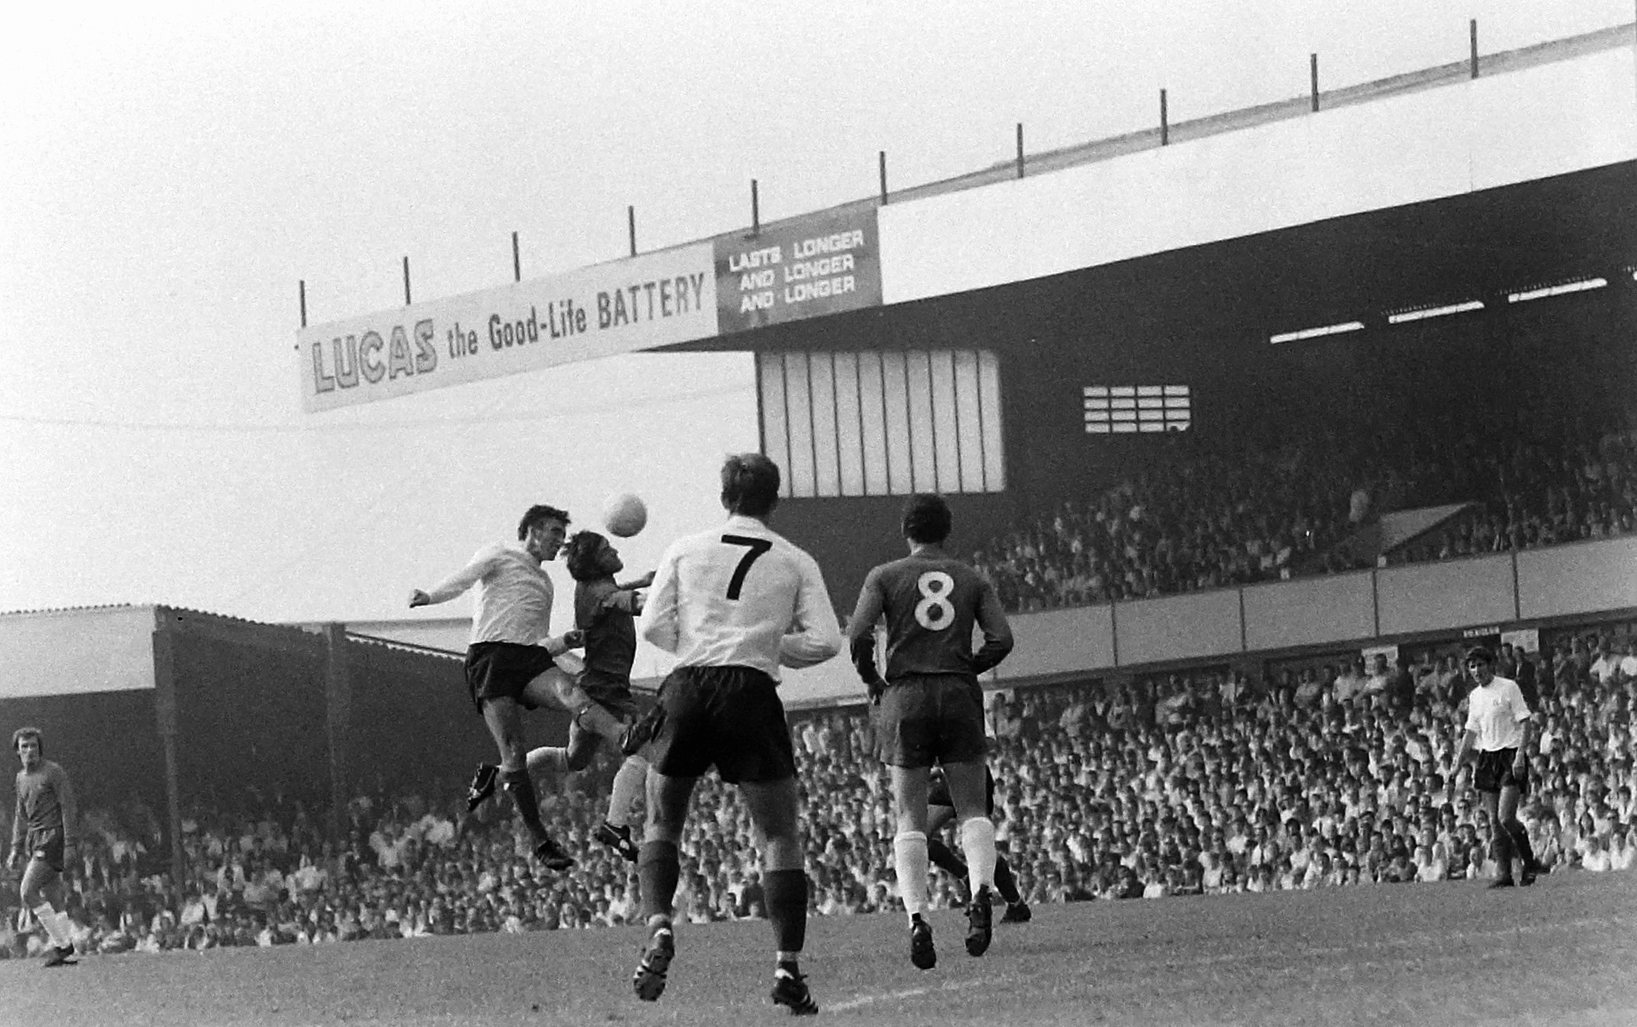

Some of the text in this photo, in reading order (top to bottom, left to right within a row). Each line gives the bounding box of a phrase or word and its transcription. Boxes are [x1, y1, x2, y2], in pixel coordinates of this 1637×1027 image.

[729, 229, 863, 272] LASTS LONGER
[740, 253, 854, 291] AND LONGER
[740, 274, 855, 314] AND LONGER
[312, 272, 704, 394] LUCAS the Good-Life BATTERY
[721, 534, 773, 600] 7
[914, 571, 955, 631] 8
